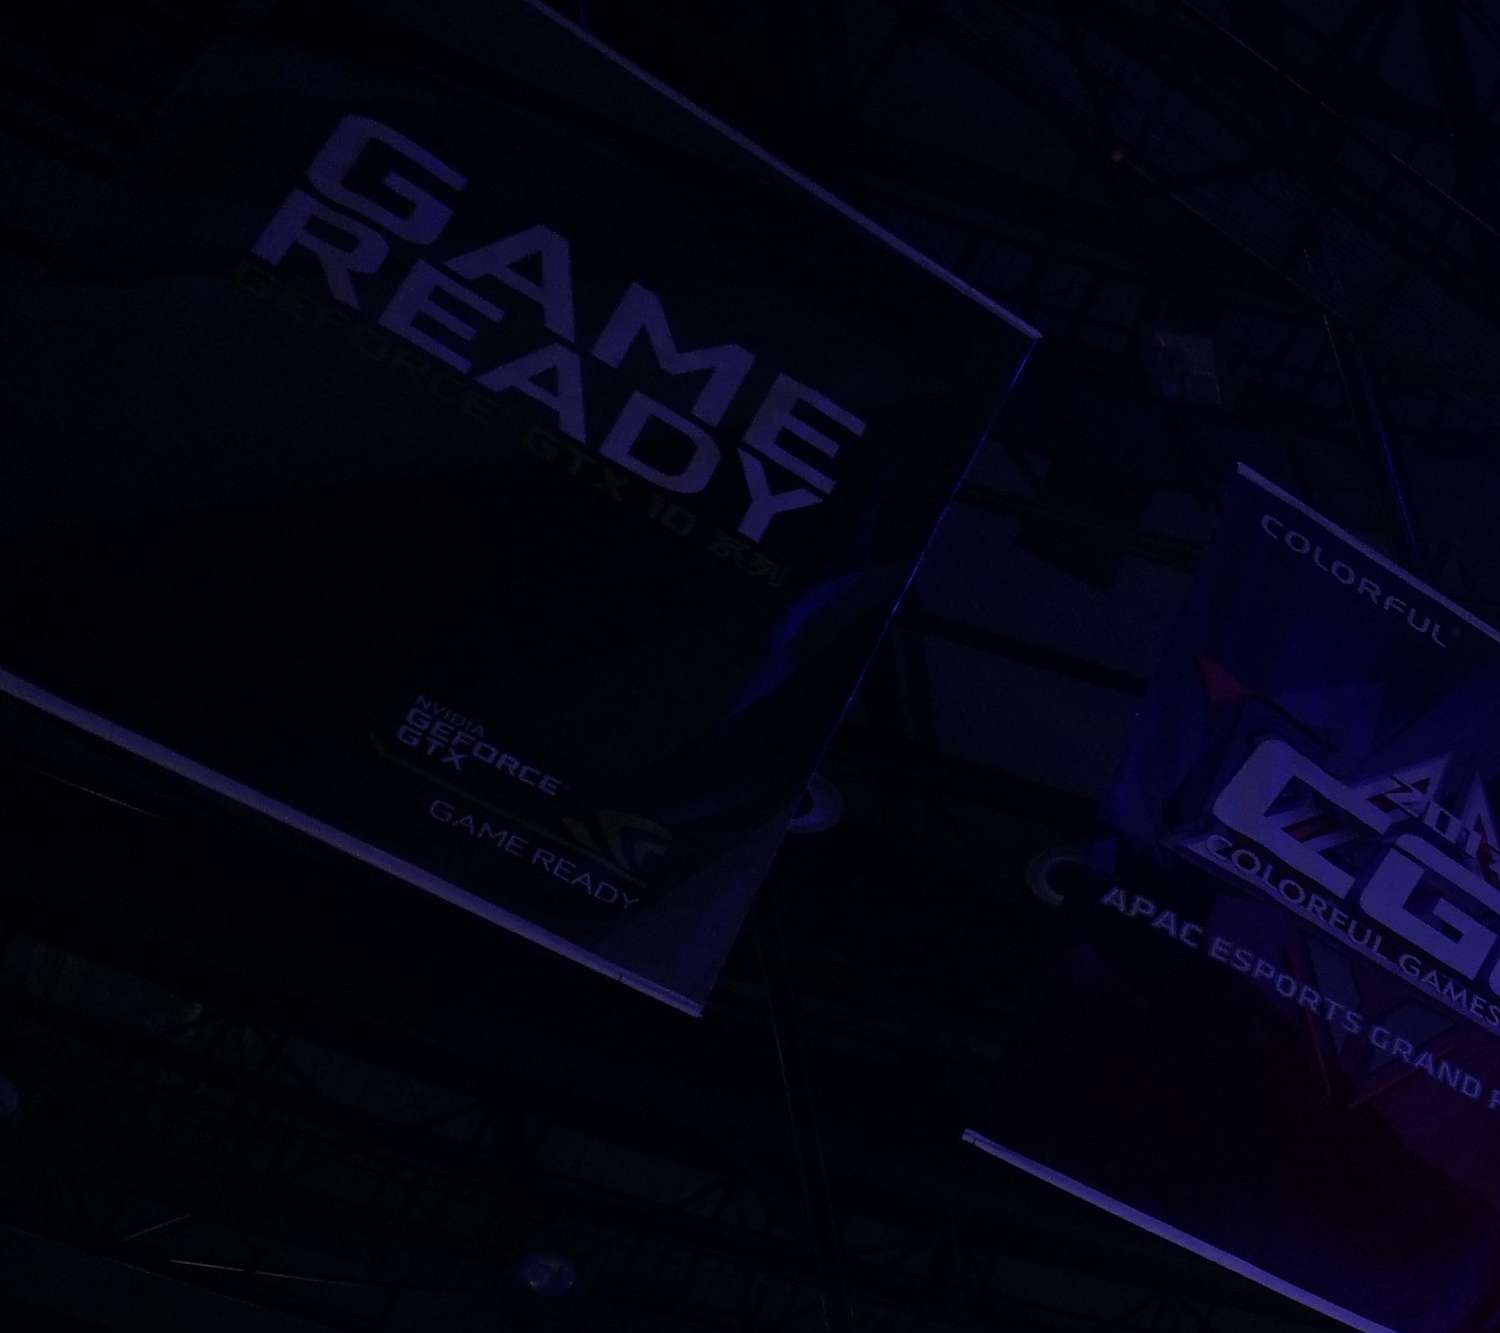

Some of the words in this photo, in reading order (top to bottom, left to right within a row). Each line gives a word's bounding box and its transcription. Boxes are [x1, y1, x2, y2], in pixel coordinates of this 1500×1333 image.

[250, 186, 825, 543] READY
[306, 112, 869, 496] GAME
[1259, 511, 1448, 649] COLORFUL
[395, 724, 468, 772] GTX
[403, 706, 563, 797] GEFORCE
[413, 694, 486, 737] NVIDIA
[427, 798, 531, 857] GAME
[530, 847, 640, 913] READY
[1205, 833, 1390, 955] COLORFUL
[1100, 884, 1205, 951] APAC
[1208, 936, 1363, 1035] ESPORTS
[1367, 1023, 1485, 1102] GRAND
